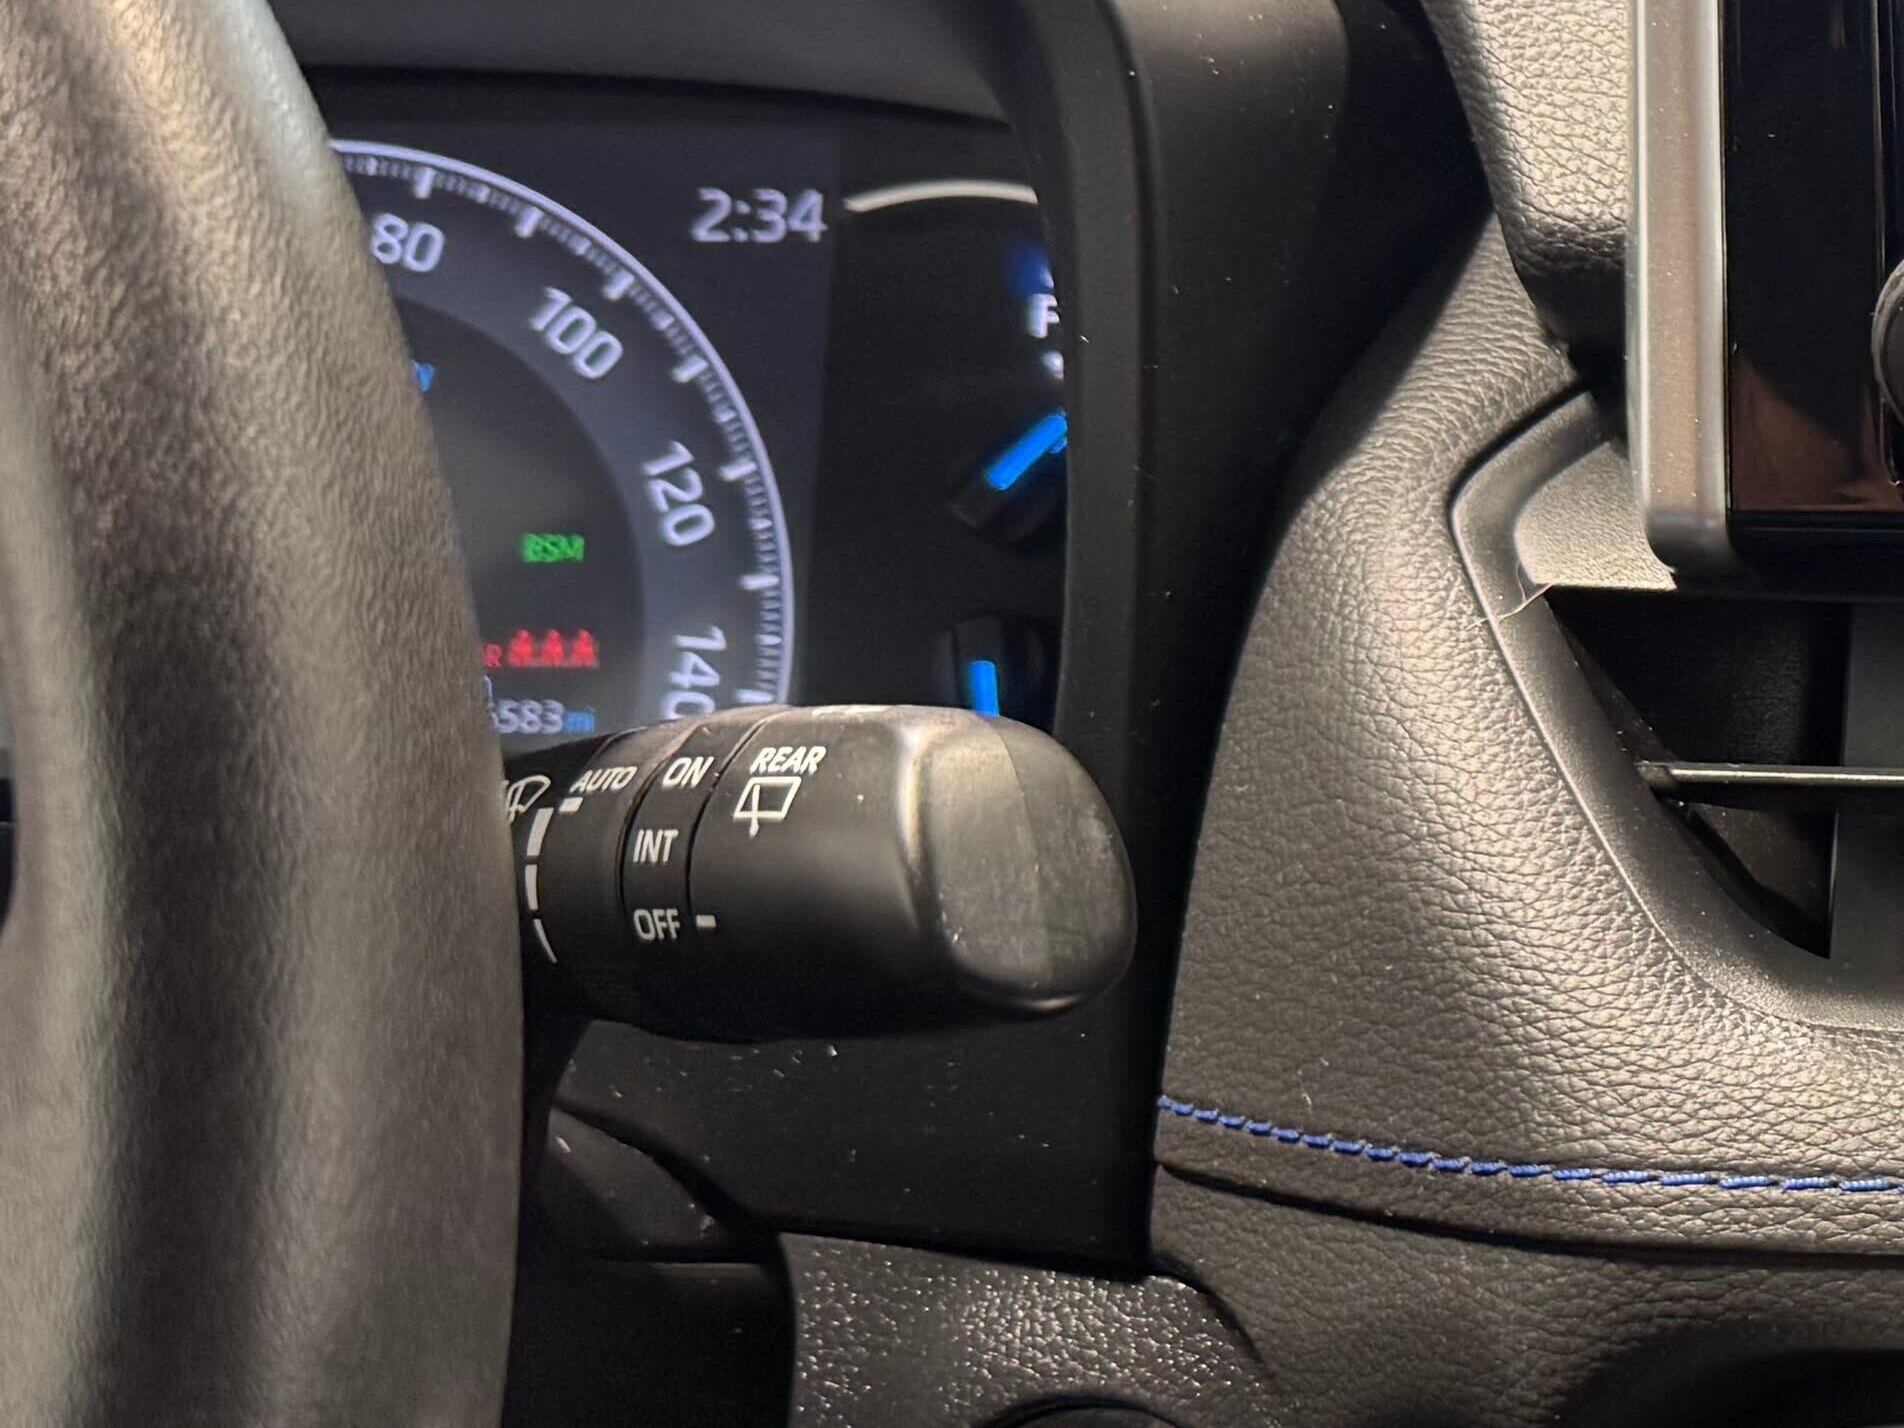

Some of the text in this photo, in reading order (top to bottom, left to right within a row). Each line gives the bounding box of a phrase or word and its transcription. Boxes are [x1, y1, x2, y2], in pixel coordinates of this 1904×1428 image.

[692, 186, 829, 244] 2:34
[370, 211, 446, 274] 80
[528, 285, 625, 381] 100
[642, 440, 717, 548] 120
[660, 624, 729, 721] 140
[489, 698, 565, 735] 583
[661, 755, 715, 789] ON
[749, 745, 827, 775] REAR
[568, 766, 638, 794] AUTO
[632, 828, 679, 863] INT
[633, 908, 681, 941] OFF
